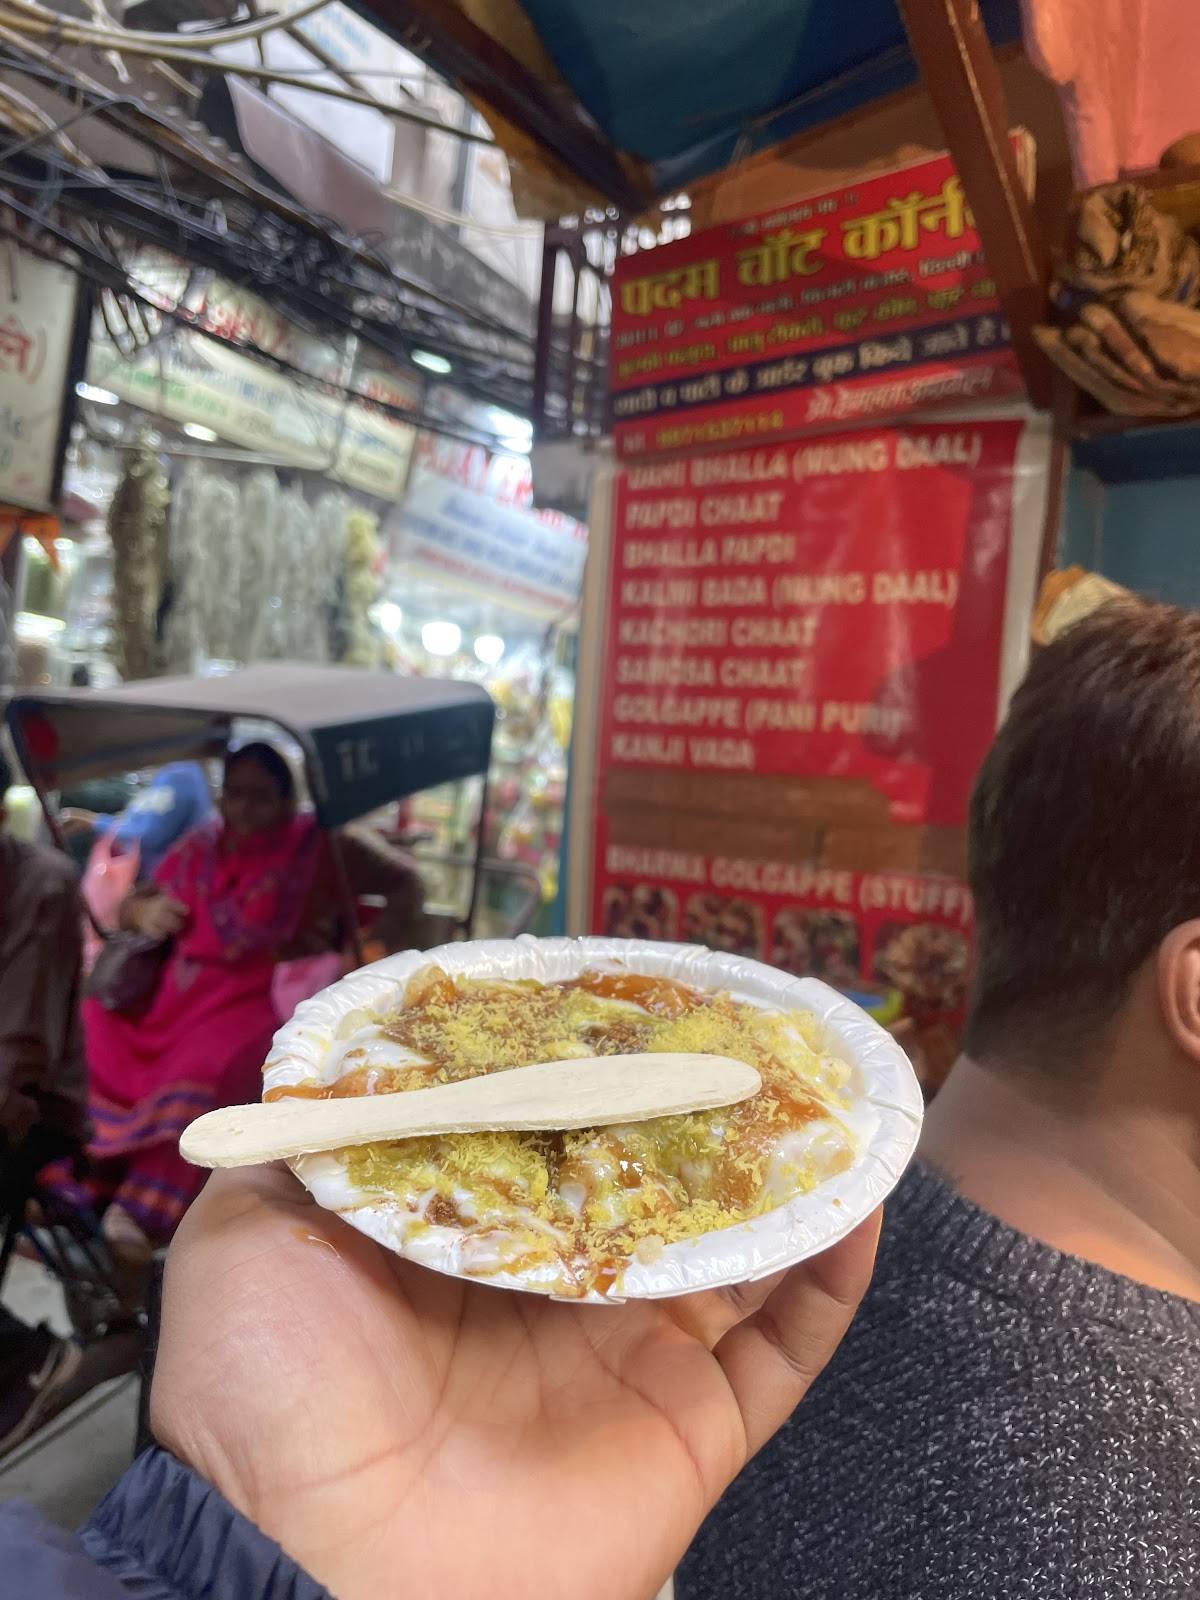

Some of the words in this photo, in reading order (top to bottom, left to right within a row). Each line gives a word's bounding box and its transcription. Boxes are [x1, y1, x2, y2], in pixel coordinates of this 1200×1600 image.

[620, 258, 720, 317] पदम
[896, 431, 983, 471] DAAL)
[701, 490, 784, 526] CHAAT
[623, 537, 717, 569] BHALLA
[872, 570, 959, 611] DAAL)
[731, 615, 817, 648] CHAAT
[719, 656, 807, 688] CHAAT
